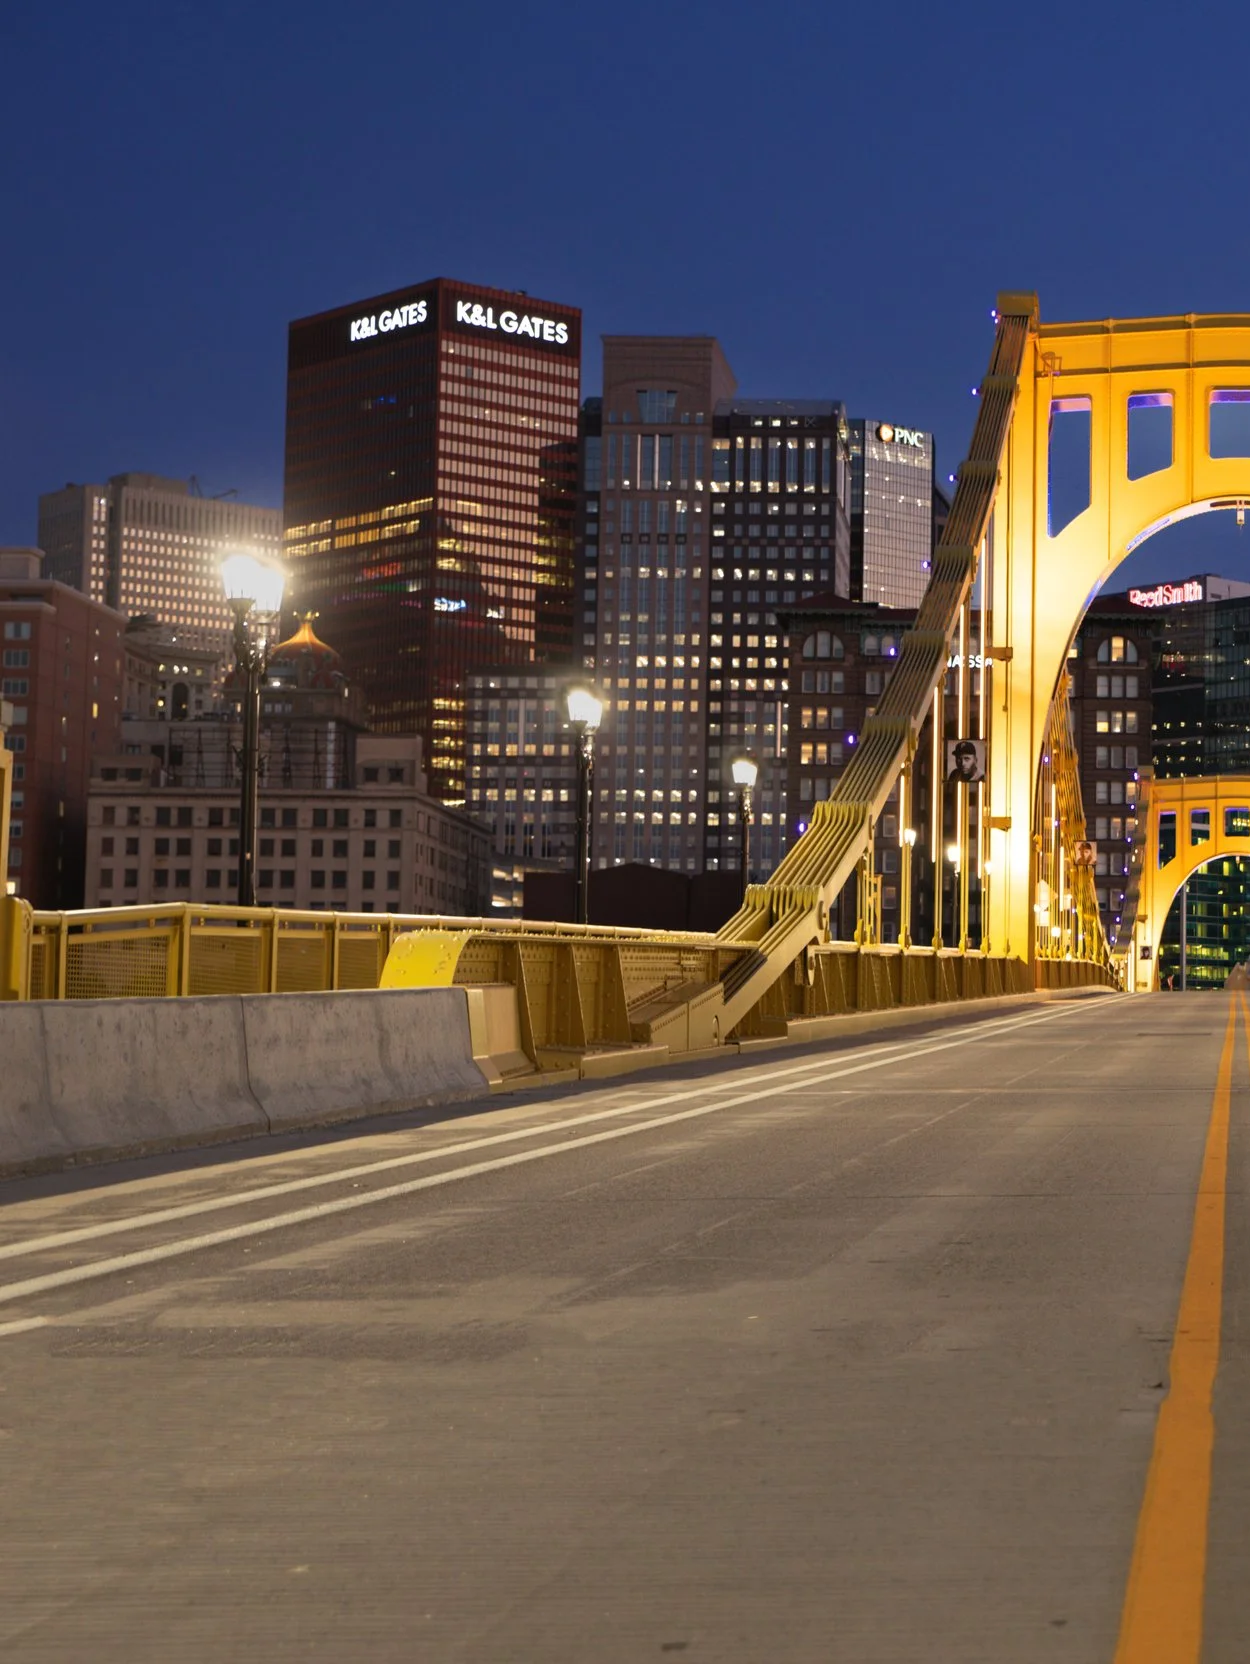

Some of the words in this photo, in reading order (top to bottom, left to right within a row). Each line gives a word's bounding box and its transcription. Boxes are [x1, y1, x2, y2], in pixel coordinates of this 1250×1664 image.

[350, 314, 378, 342] K&L
[378, 300, 427, 332] GATES
[456, 301, 498, 330] K&L
[500, 311, 569, 344] GATES
[894, 428, 924, 448] PNC
[1130, 586, 1163, 607] Reed
[1163, 582, 1202, 605] Smith
